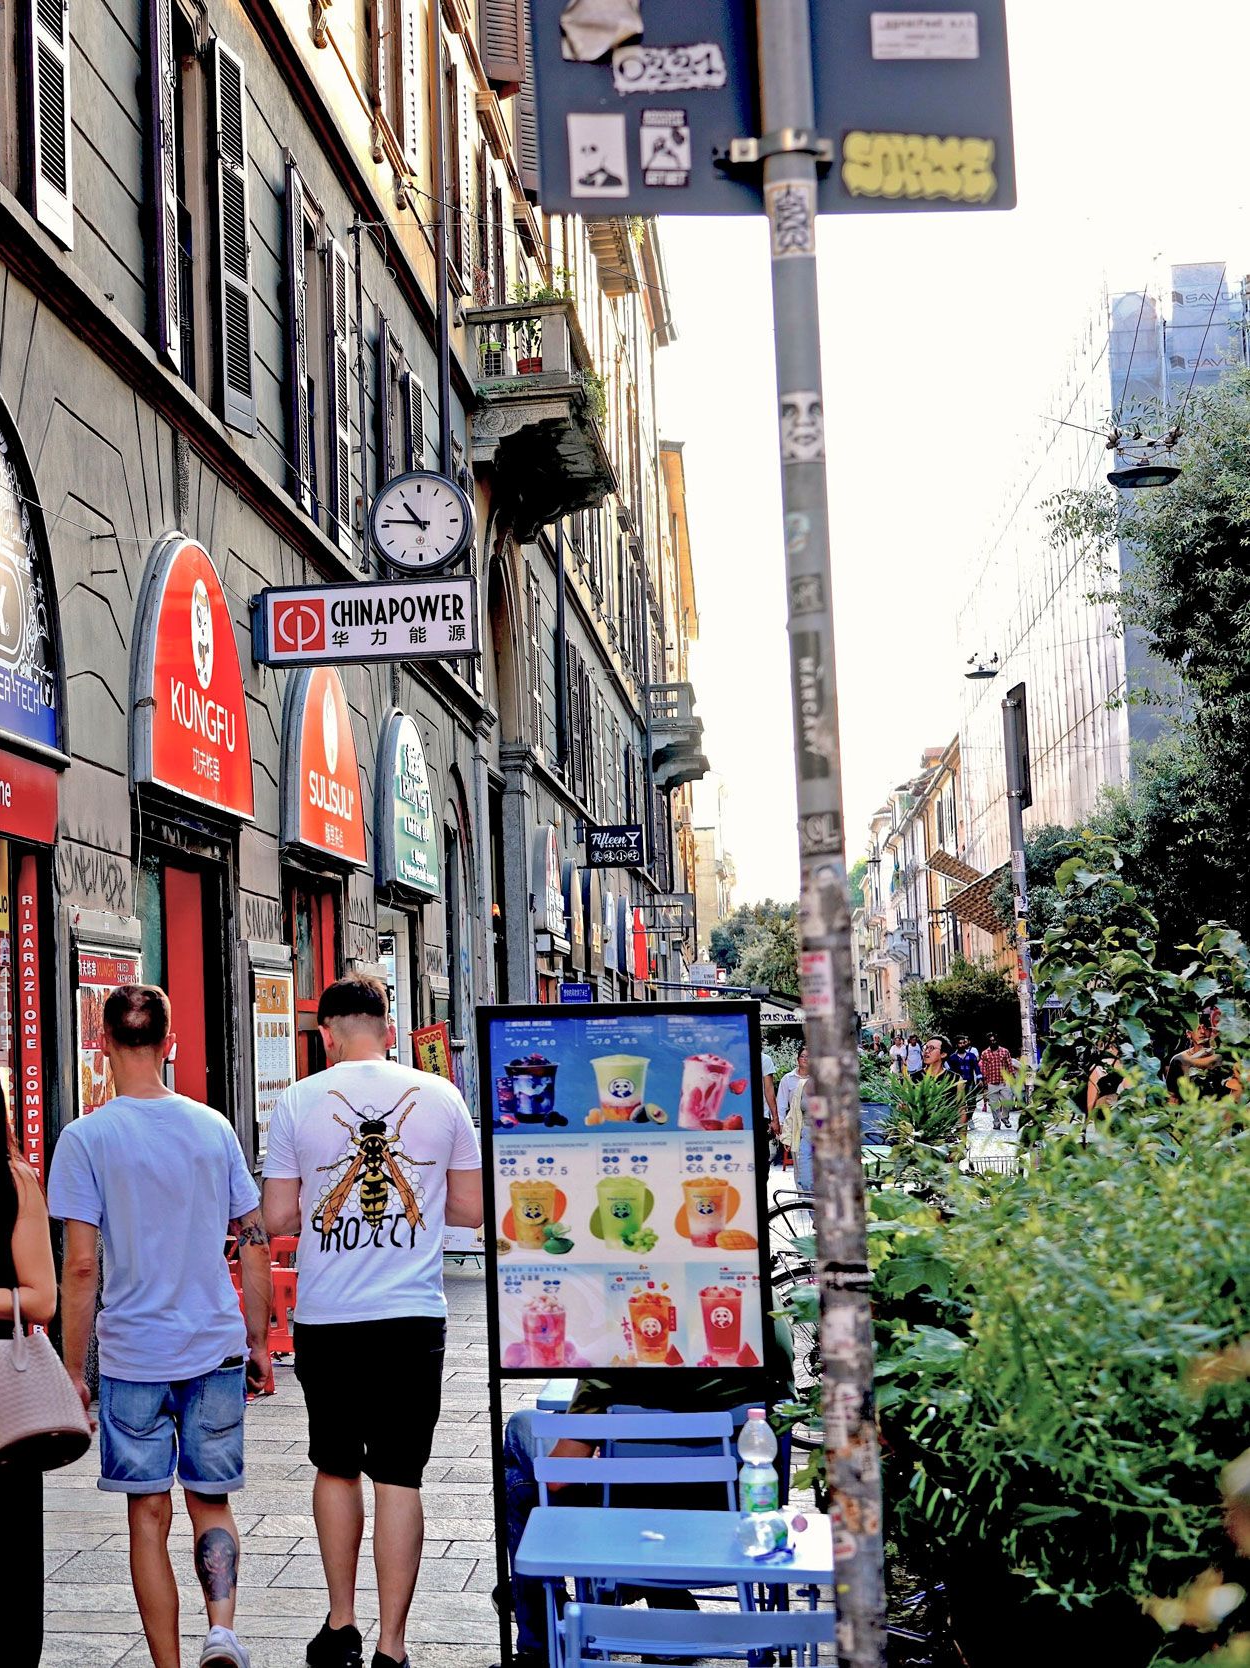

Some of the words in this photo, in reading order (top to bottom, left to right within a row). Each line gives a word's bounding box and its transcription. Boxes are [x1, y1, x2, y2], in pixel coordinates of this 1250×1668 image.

[330, 593, 466, 628] CHINAPOWER
[331, 624, 467, 648] 华力能源
[15, 680, 40, 716] TECH
[170, 677, 236, 753] KUNGFU
[590, 832, 627, 849] Fifteen
[21, 895, 38, 1050] RIPARAZIONE
[25, 1065, 42, 1179] COMPUTER
[603, 1164, 620, 1175] €6
[631, 1164, 649, 1174] €7
